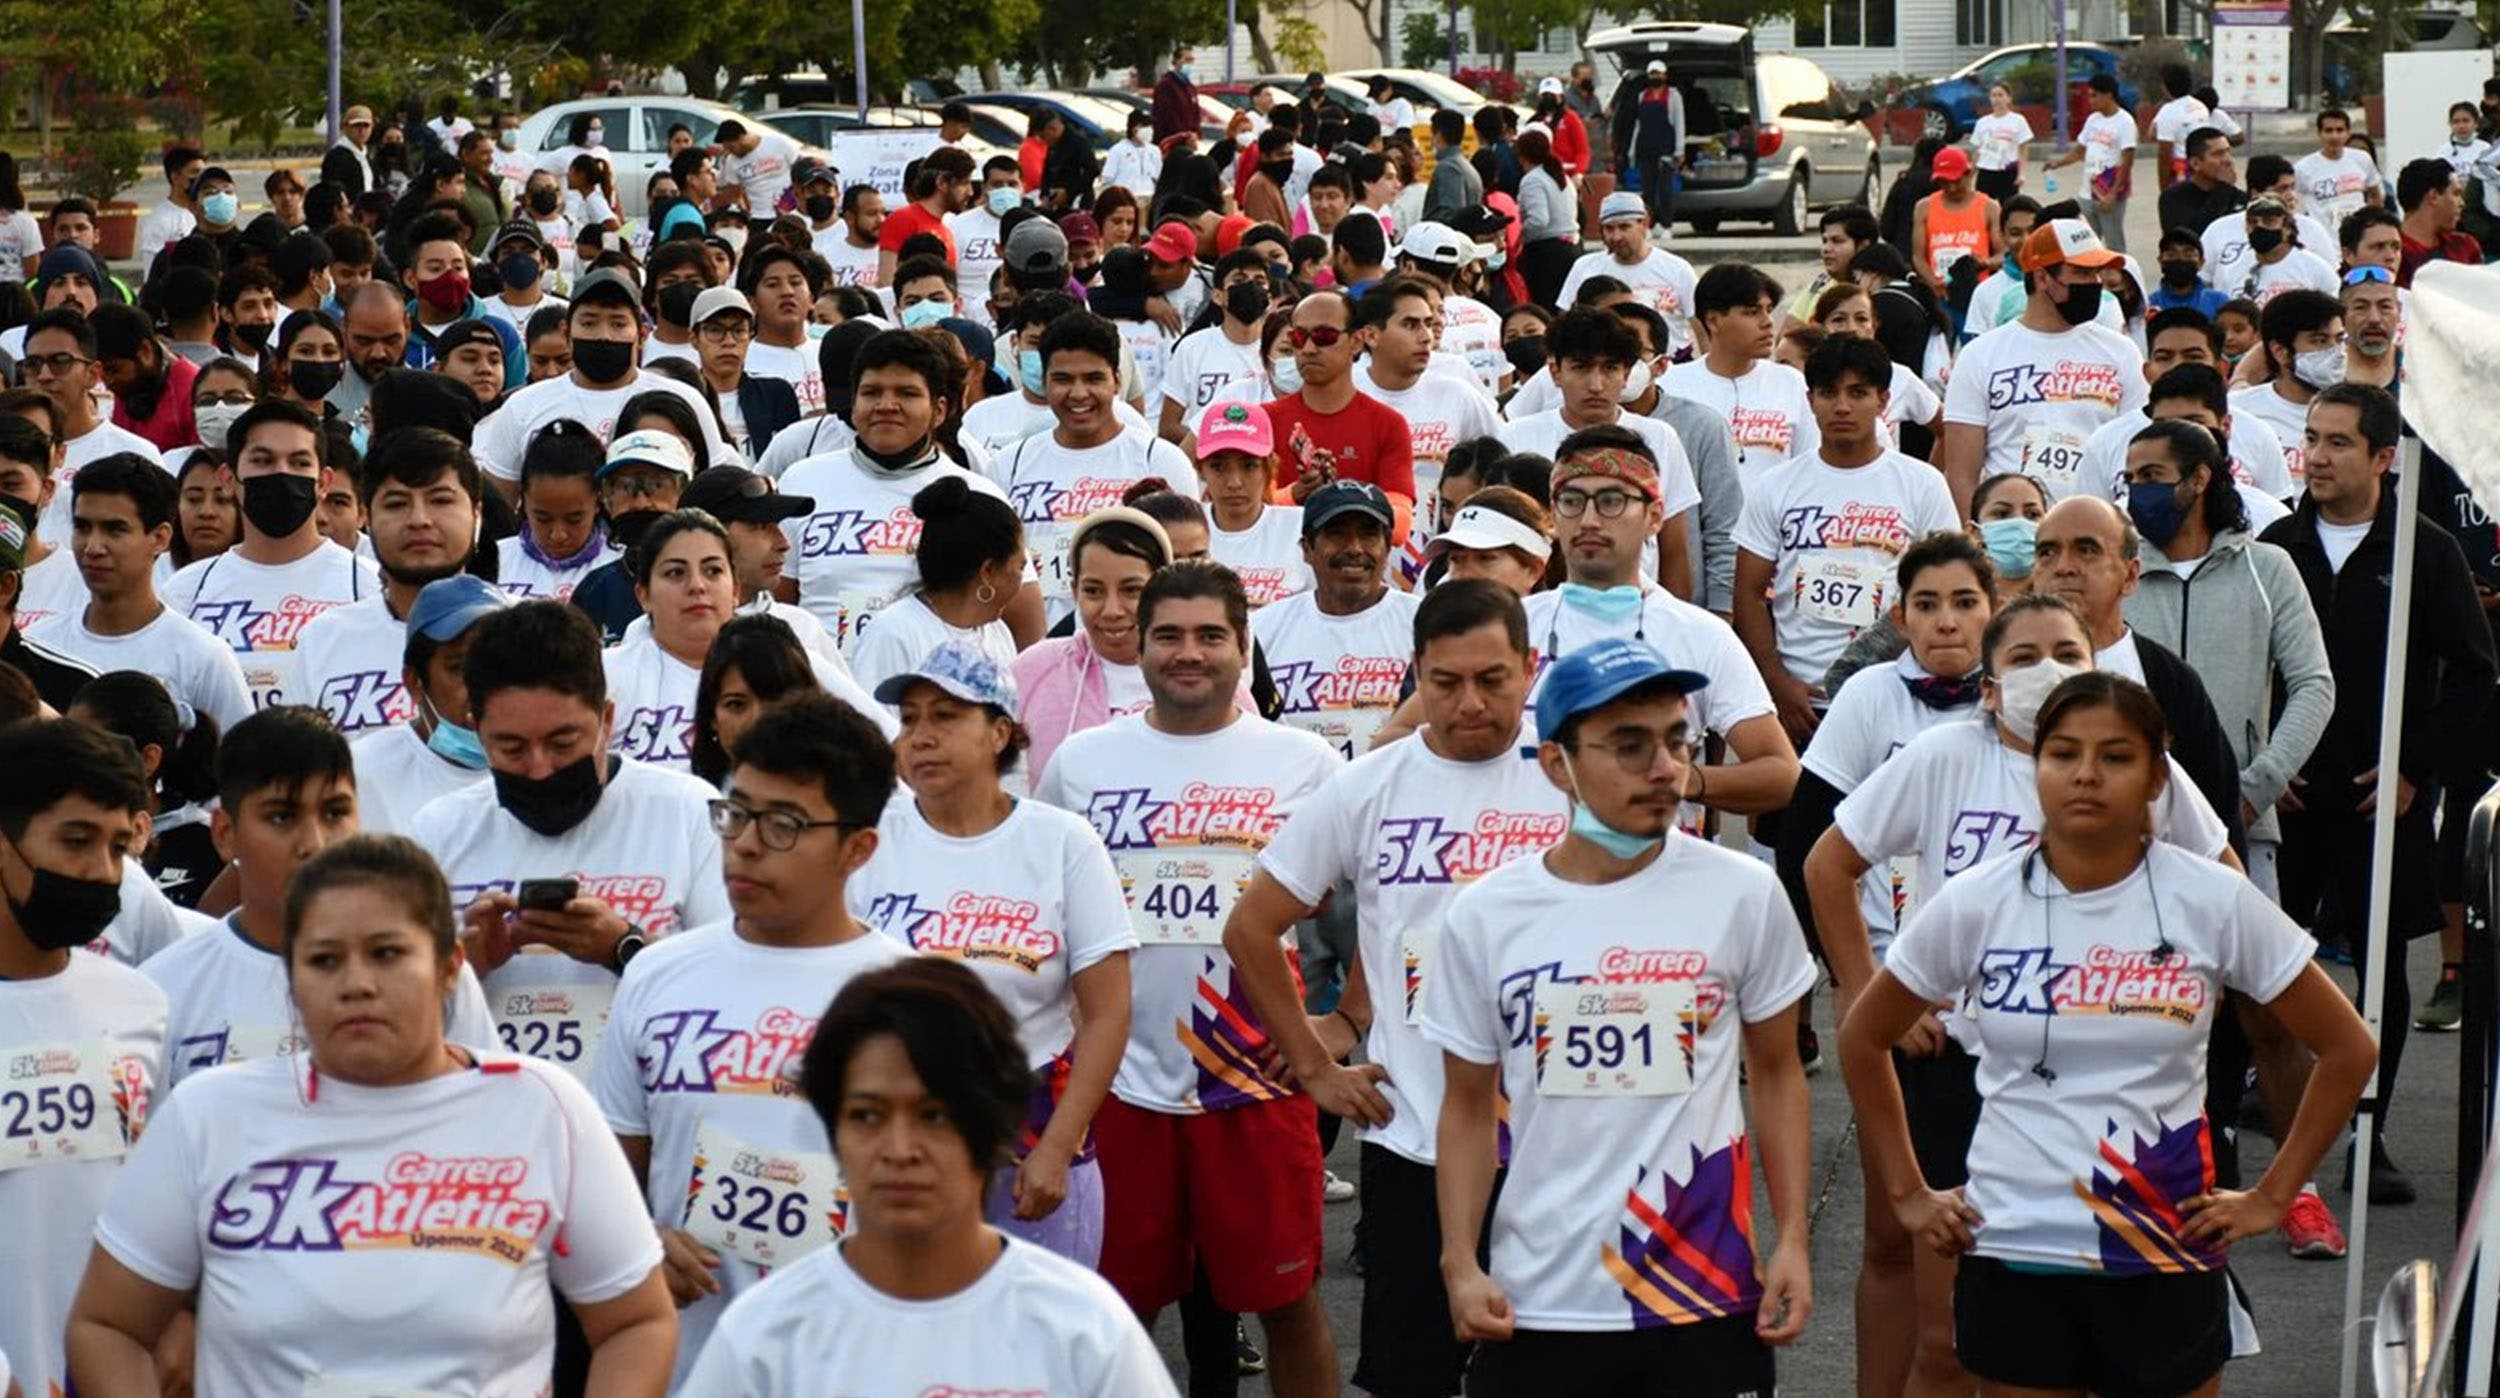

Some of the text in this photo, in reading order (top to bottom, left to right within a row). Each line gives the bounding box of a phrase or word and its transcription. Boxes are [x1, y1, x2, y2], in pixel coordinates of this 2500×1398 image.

[1988, 364, 2050, 410] 5k
[2036, 447, 2084, 472] 497
[801, 511, 874, 558] 5k
[1780, 506, 1832, 550] 5k
[1811, 579, 1863, 608] 367
[1337, 653, 1405, 674] Carrera
[318, 671, 402, 731] 5k
[623, 705, 695, 761] 5k
[1181, 781, 1275, 807] Carrera
[1088, 788, 1174, 850] 5k
[1476, 810, 1567, 836] Carrera
[1379, 817, 1465, 885] 5k
[949, 891, 1039, 922] Carrera
[1144, 884, 1220, 919] 404
[915, 911, 1060, 957] Atlética
[1601, 947, 1708, 978] Carrera
[2087, 945, 2188, 971] Carrera
[1979, 948, 2206, 1015] 5k Atlética
[2108, 1003, 2165, 1015] Upemor
[498, 1021, 582, 1062] 325
[637, 1010, 740, 1093] 5k
[1566, 1023, 1651, 1068] 591
[2, 1083, 94, 1138] 259
[386, 1153, 527, 1187] Carrera
[207, 1159, 548, 1251] 5k Atlética
[710, 1176, 809, 1238] 326
[411, 1231, 484, 1248] Upemor
